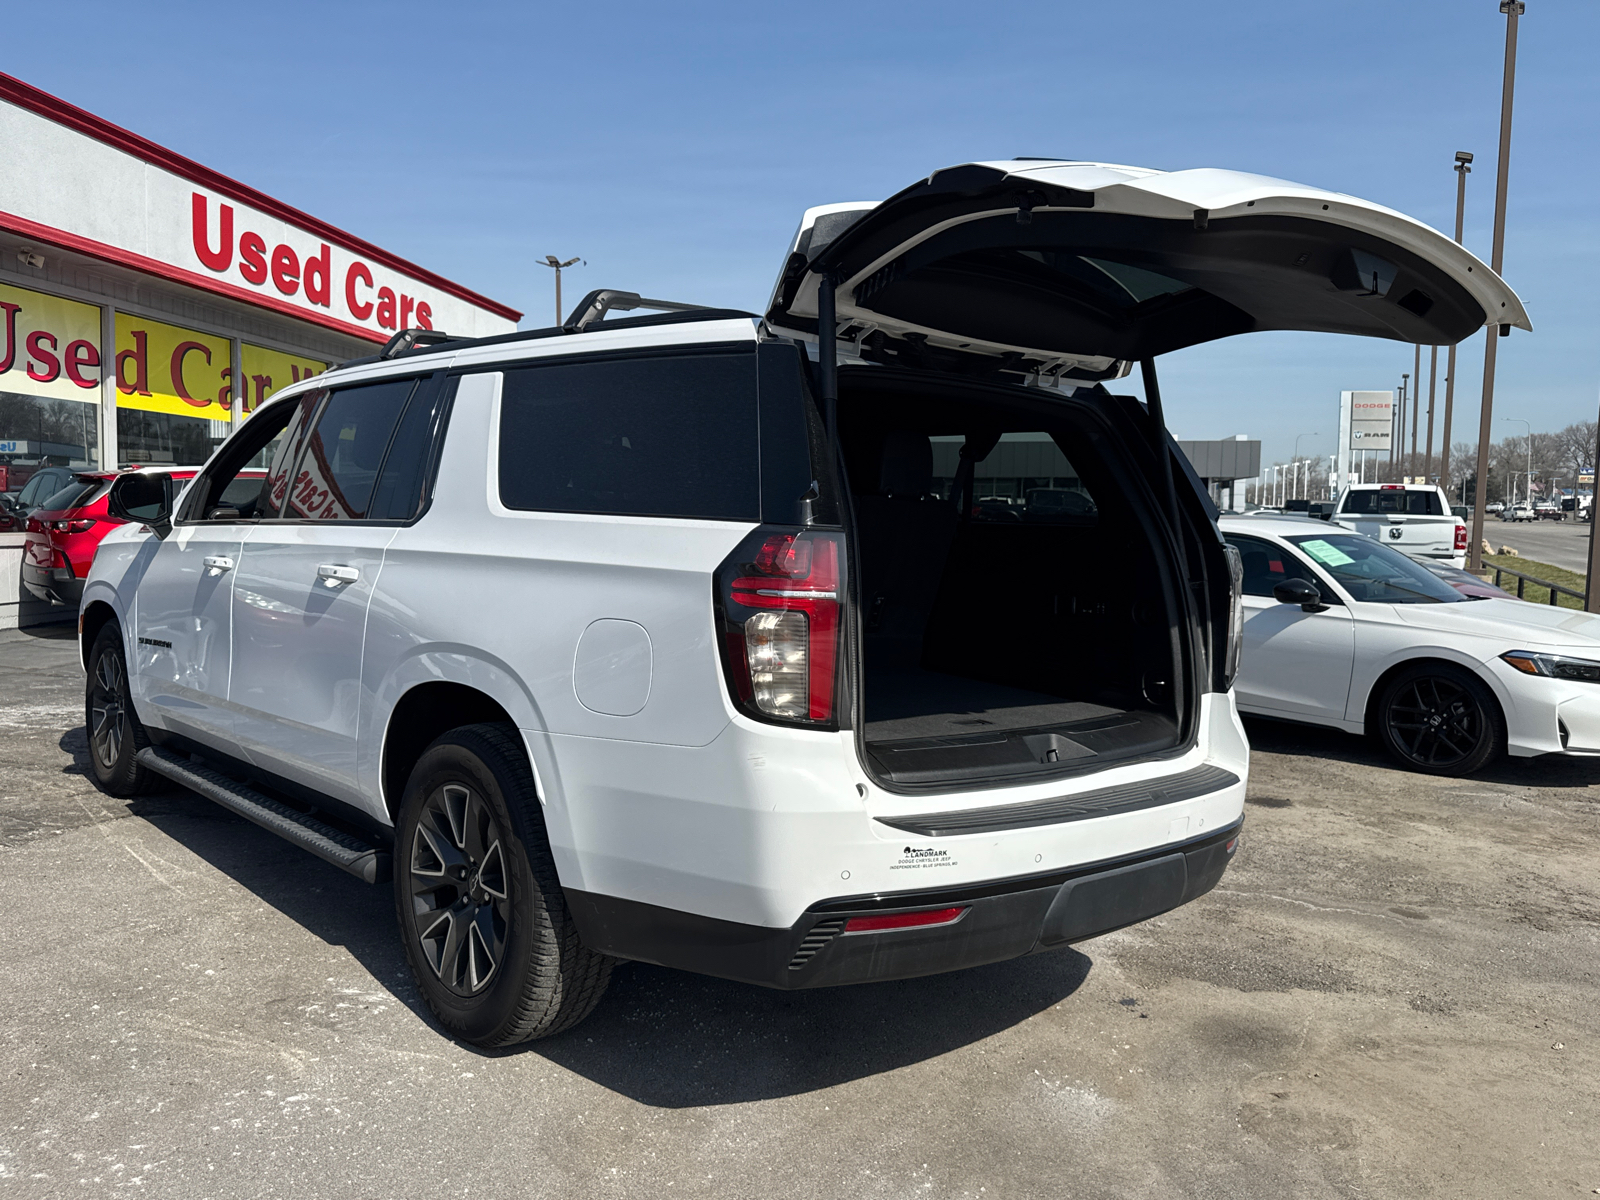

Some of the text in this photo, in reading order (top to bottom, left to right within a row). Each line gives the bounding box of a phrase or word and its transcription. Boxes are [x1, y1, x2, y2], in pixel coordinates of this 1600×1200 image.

[192, 191, 433, 331] Used Cars
[170, 341, 272, 414] Car
[911, 850, 947, 858] LANDMARK
